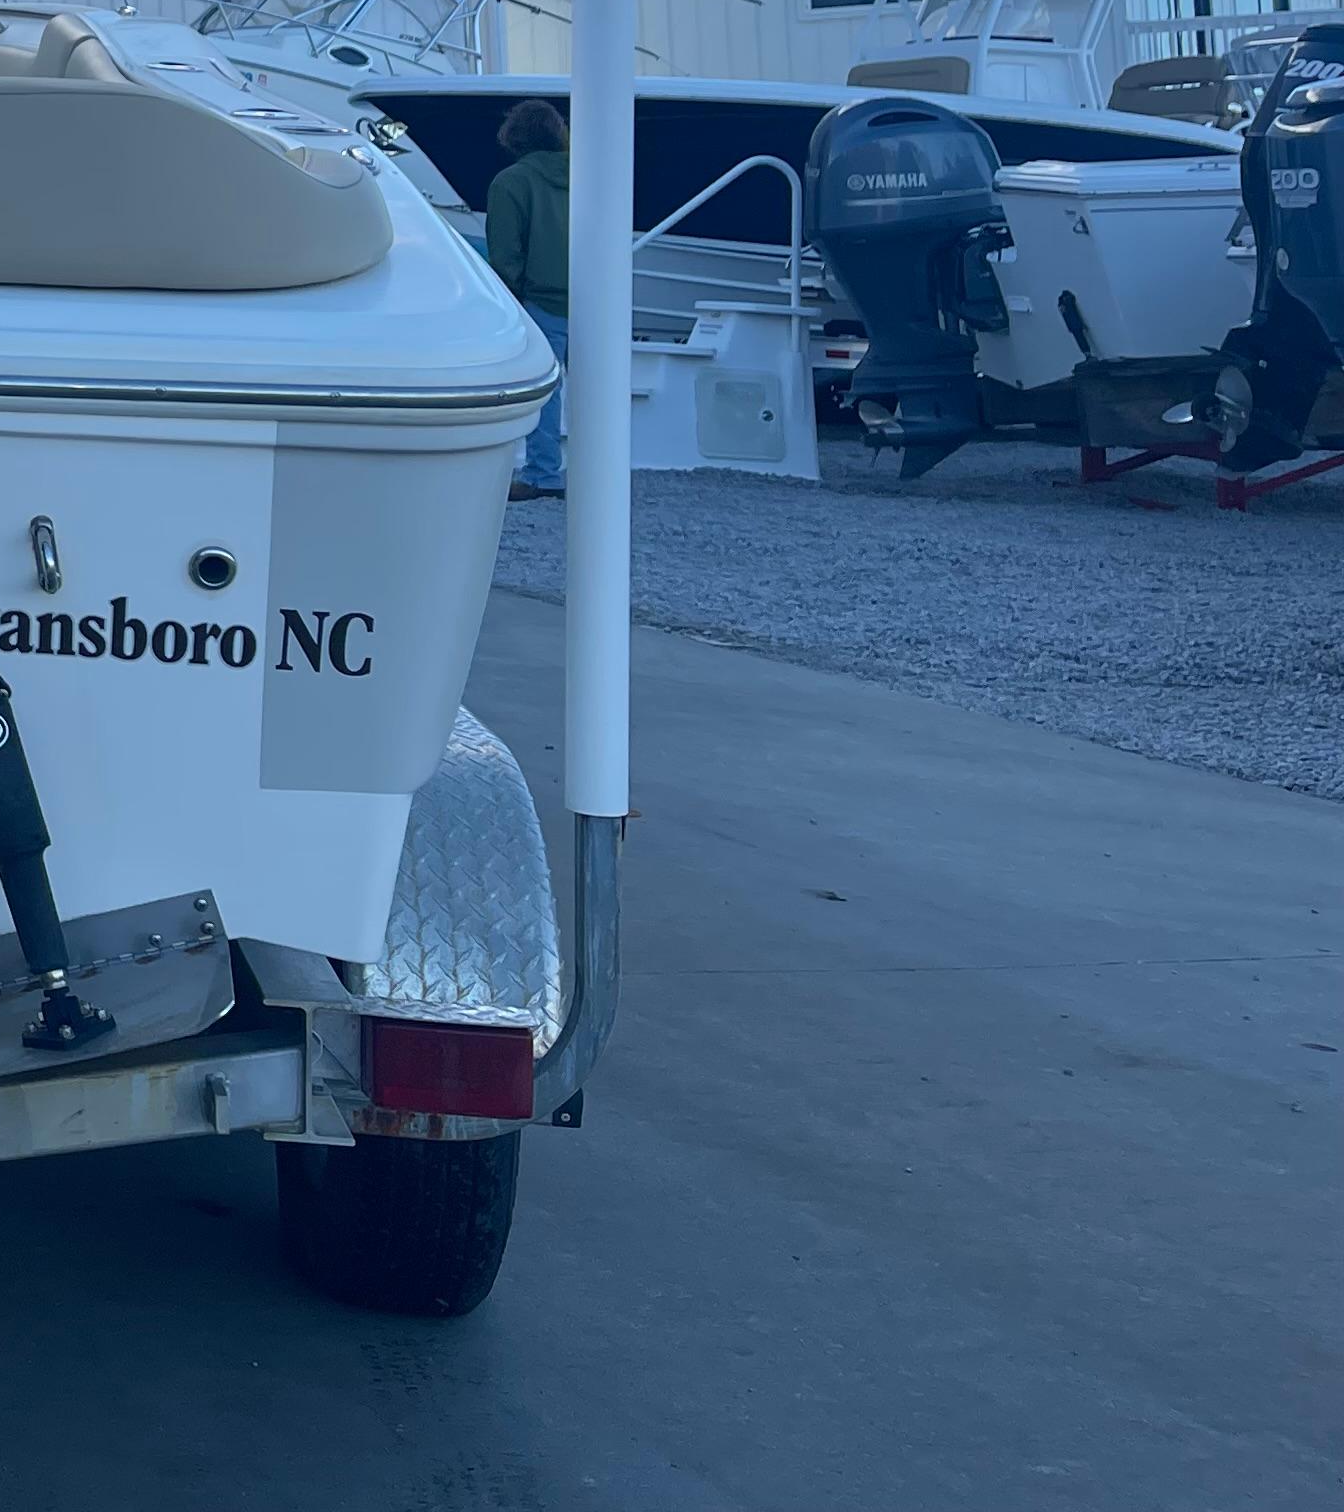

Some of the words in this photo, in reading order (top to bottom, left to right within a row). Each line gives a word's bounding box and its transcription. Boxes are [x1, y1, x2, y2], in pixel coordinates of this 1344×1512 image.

[1285, 58, 1344, 80] 200
[865, 172, 928, 190] YAMAHA
[274, 607, 376, 677] NC
